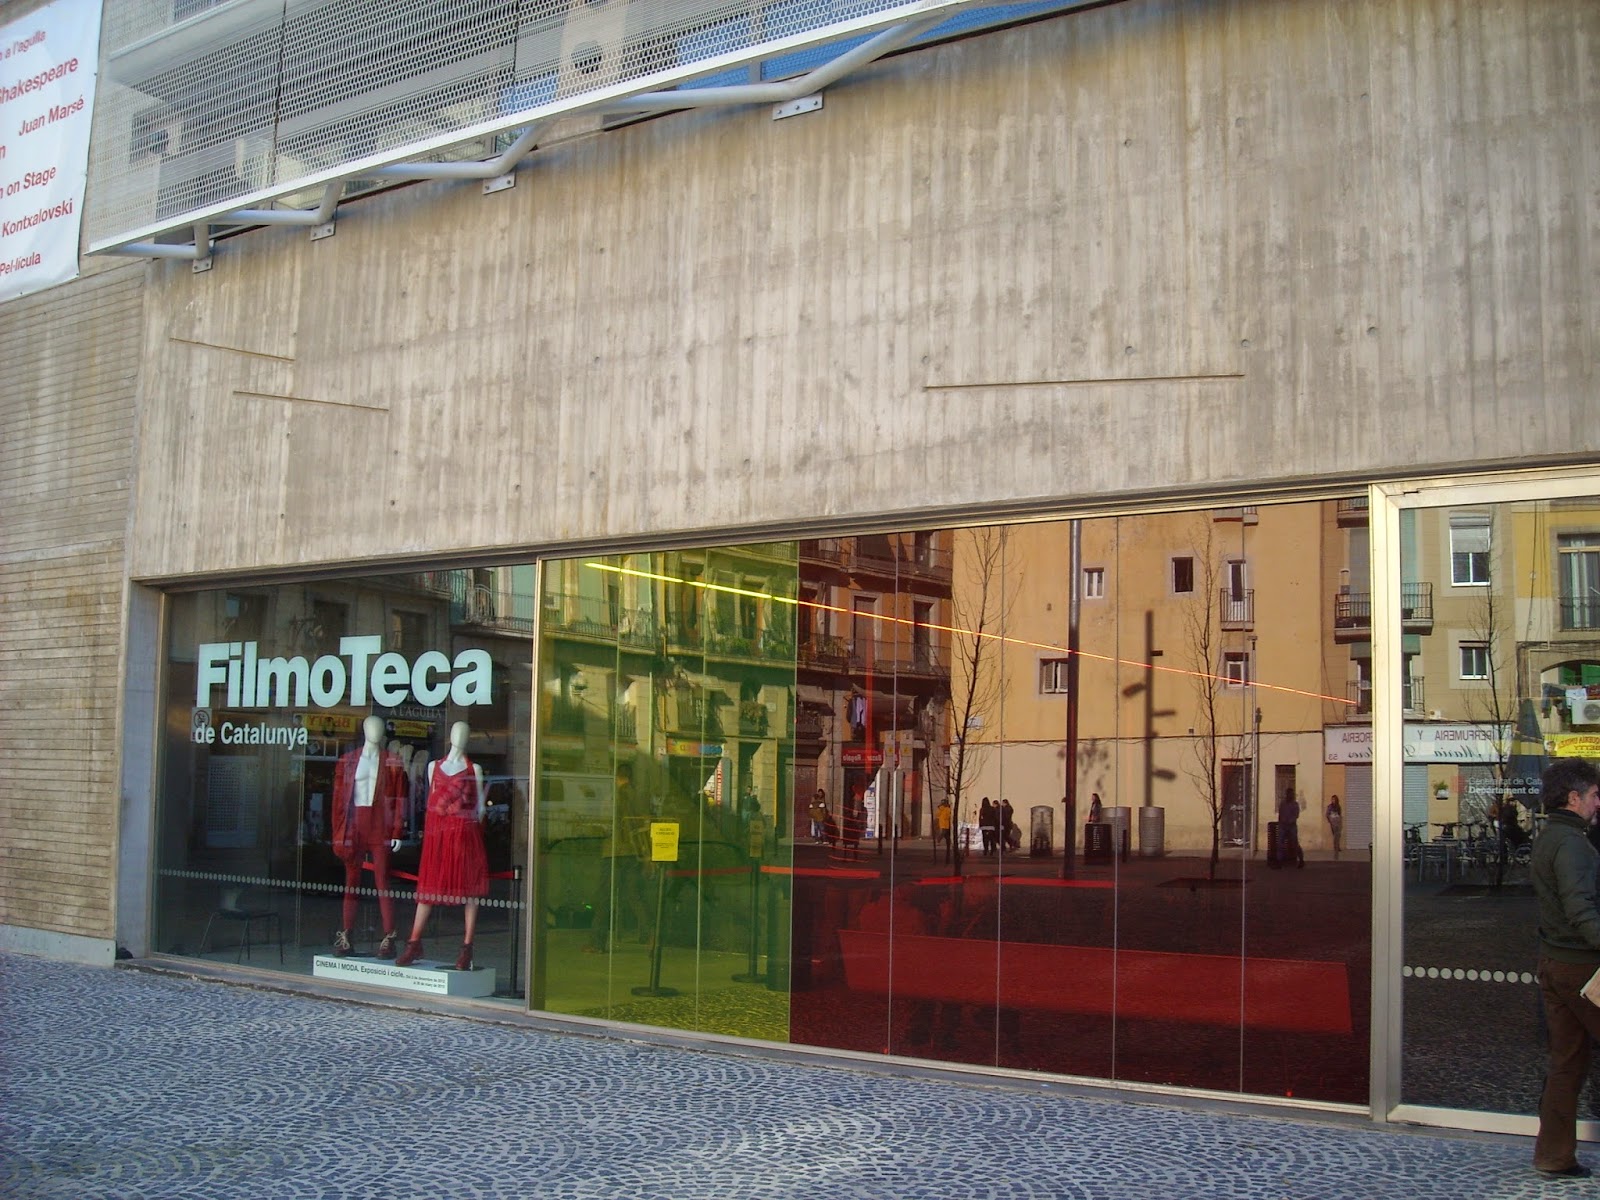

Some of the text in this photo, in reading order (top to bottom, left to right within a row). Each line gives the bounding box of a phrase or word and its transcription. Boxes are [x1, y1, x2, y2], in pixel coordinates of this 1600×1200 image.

[19, 94, 84, 137] Juan Marsé
[7, 180, 20, 196] on
[23, 166, 56, 190] Stage
[2, 198, 73, 238] Kontxalovski
[196, 635, 493, 708] FilmoTeca
[195, 721, 308, 750] de Catalunya
[1468, 786, 1540, 795] Departament de
[1513, 777, 1524, 785] de
[315, 959, 337, 969] CINEMA
[360, 965, 386, 977] Exposició
